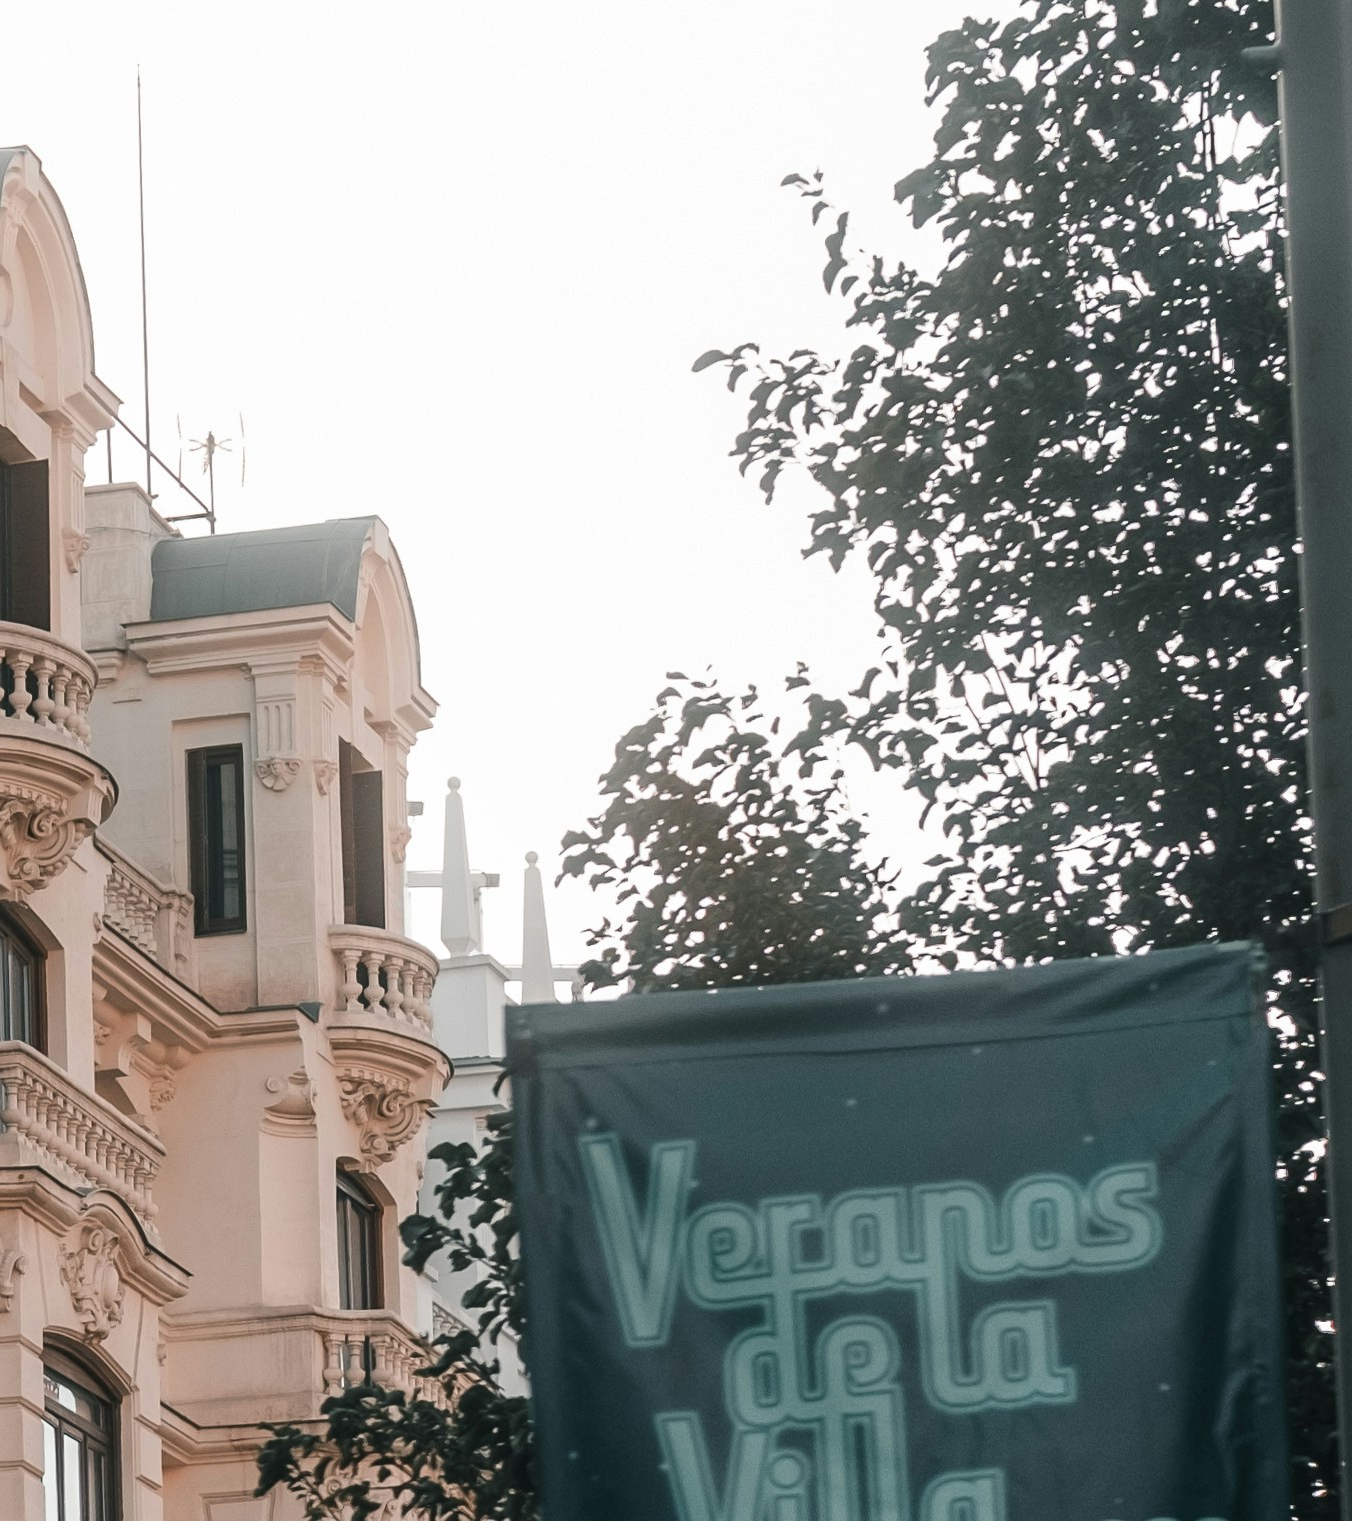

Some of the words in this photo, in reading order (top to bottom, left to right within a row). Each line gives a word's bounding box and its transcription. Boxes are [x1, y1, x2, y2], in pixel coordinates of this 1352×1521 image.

[579, 1132, 1164, 1348] Veranos
[723, 1296, 901, 1430] de
[917, 1280, 1078, 1414] la
